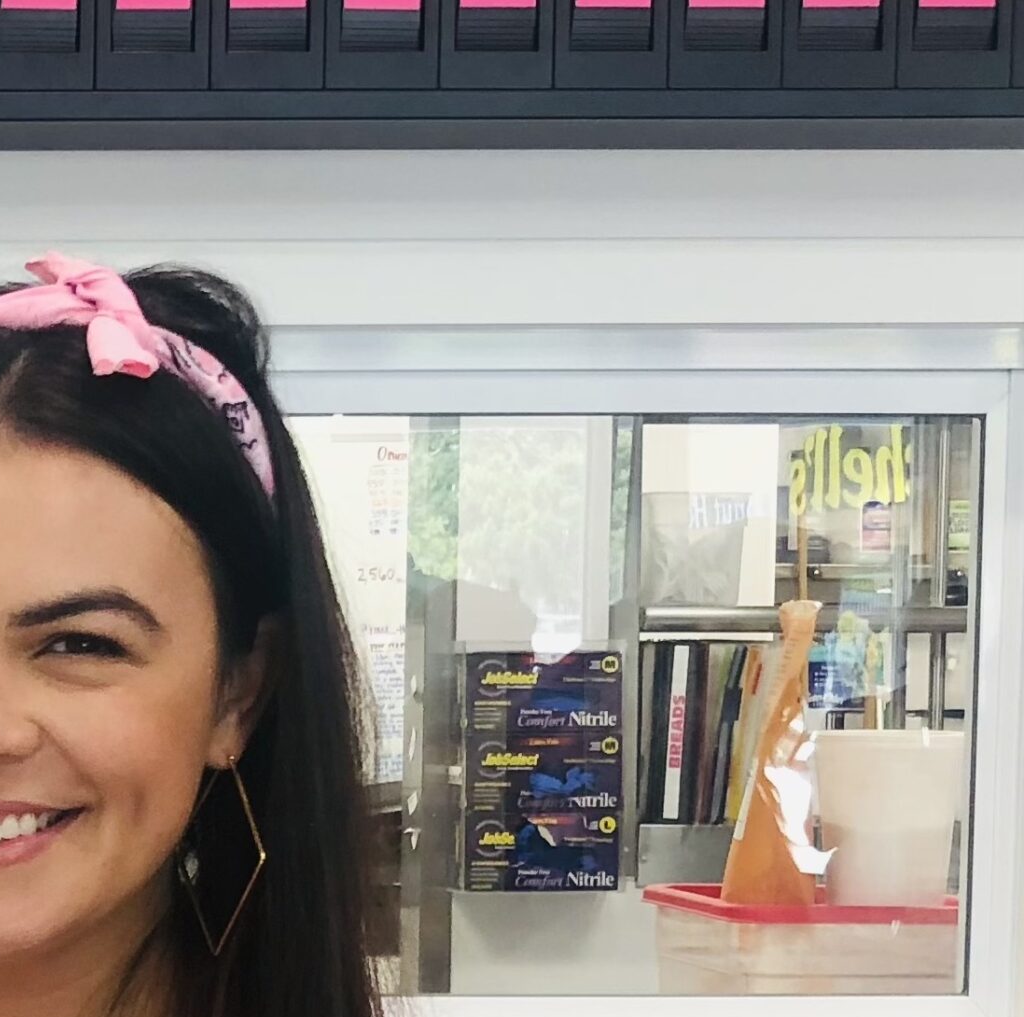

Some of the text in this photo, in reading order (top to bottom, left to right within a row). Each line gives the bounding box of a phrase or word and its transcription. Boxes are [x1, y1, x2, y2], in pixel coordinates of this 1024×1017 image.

[517, 715, 566, 729] Comfort
[568, 710, 617, 727] Nitrile
[668, 695, 686, 769] BREADS
[565, 871, 614, 887] Nitrile
